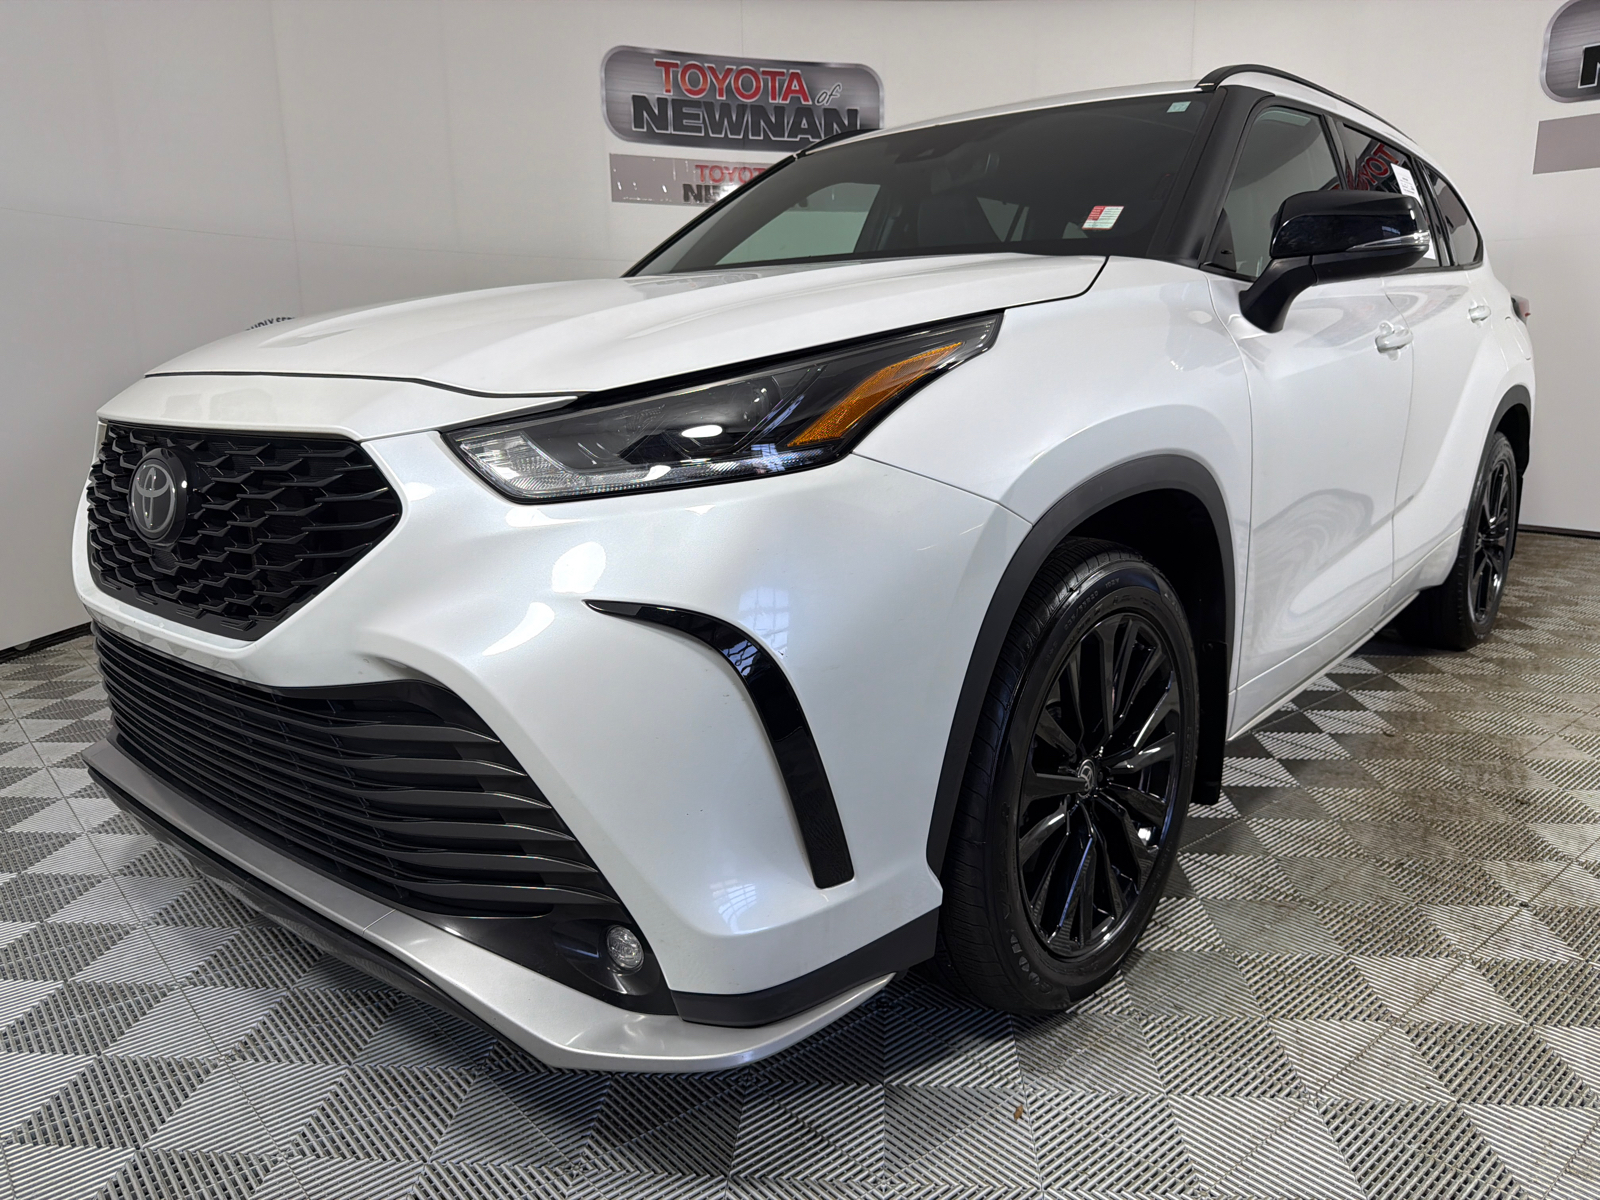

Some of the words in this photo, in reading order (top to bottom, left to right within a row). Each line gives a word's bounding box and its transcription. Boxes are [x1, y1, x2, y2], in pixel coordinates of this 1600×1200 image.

[653, 58, 812, 105] TOYOTA
[815, 82, 843, 106] of
[631, 94, 860, 142] NEWNAN
